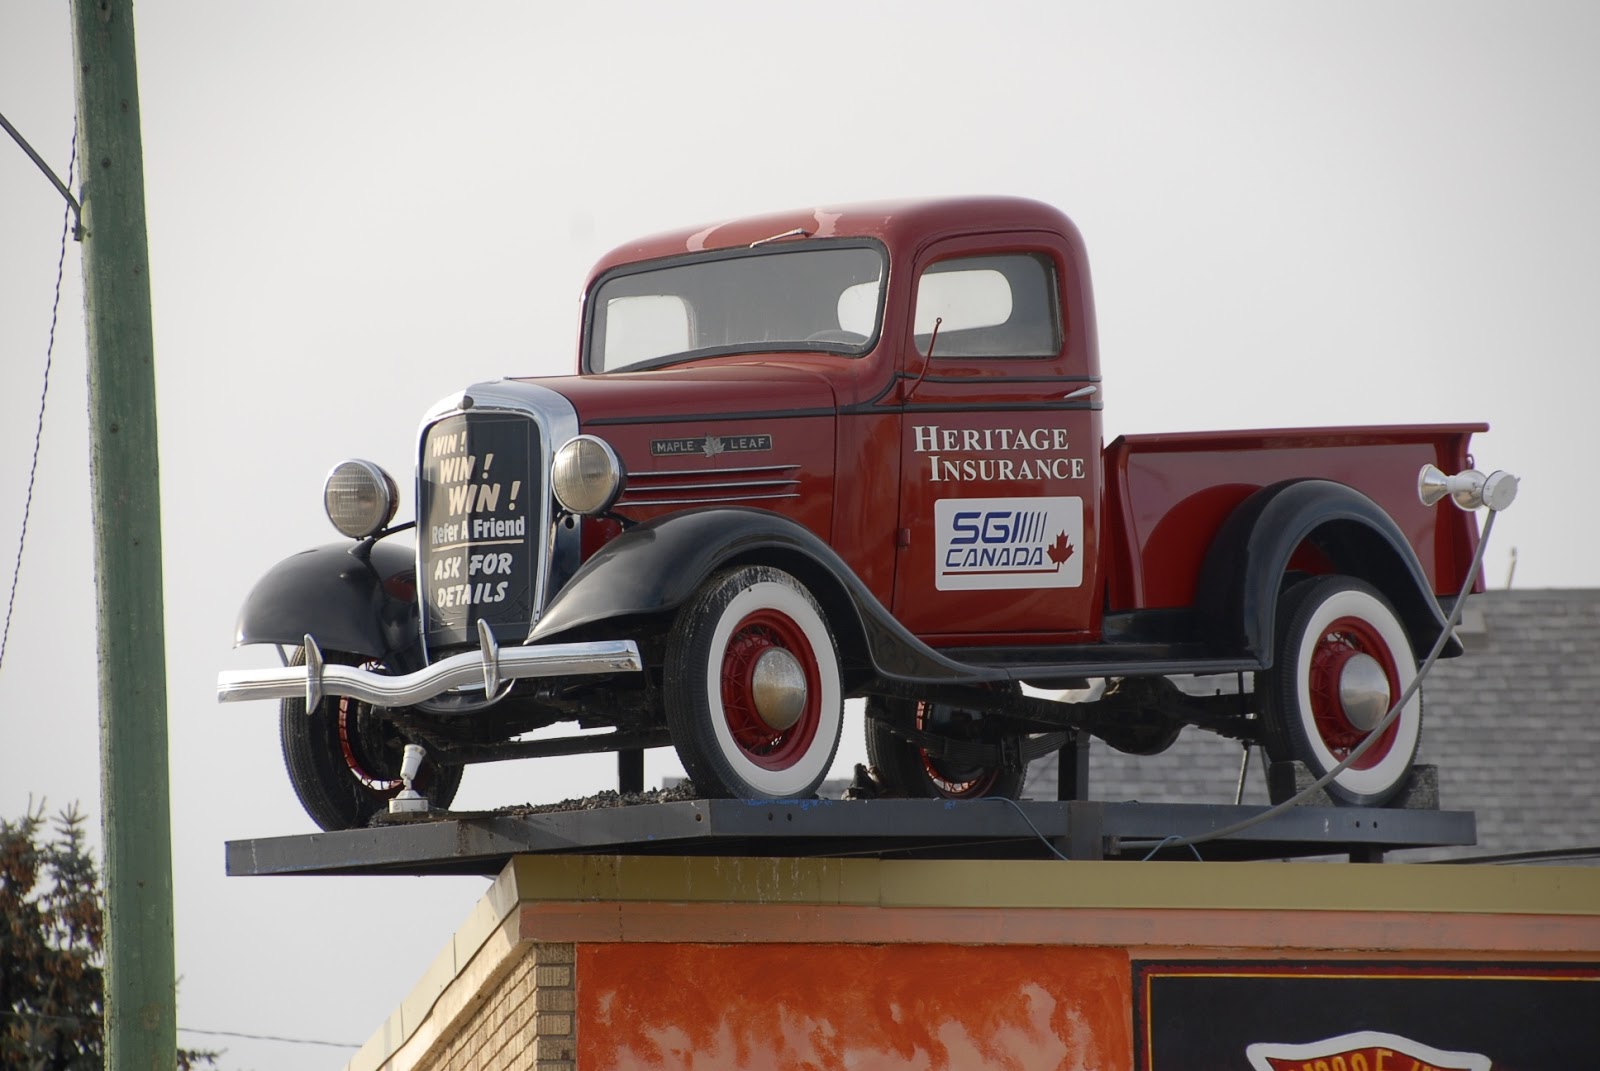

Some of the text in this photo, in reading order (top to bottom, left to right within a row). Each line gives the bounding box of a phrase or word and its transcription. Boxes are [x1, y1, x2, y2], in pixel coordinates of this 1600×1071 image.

[656, 438, 765, 452] MAPLE LEAF
[912, 425, 1069, 452] HERITAGE
[928, 455, 1086, 482] INSURANCE
[432, 516, 525, 544] Refer A Friend
[950, 511, 1022, 544] SGI
[434, 552, 513, 581] ASK FOR
[945, 547, 1043, 567] CANADA
[437, 581, 508, 608] DETAILS
